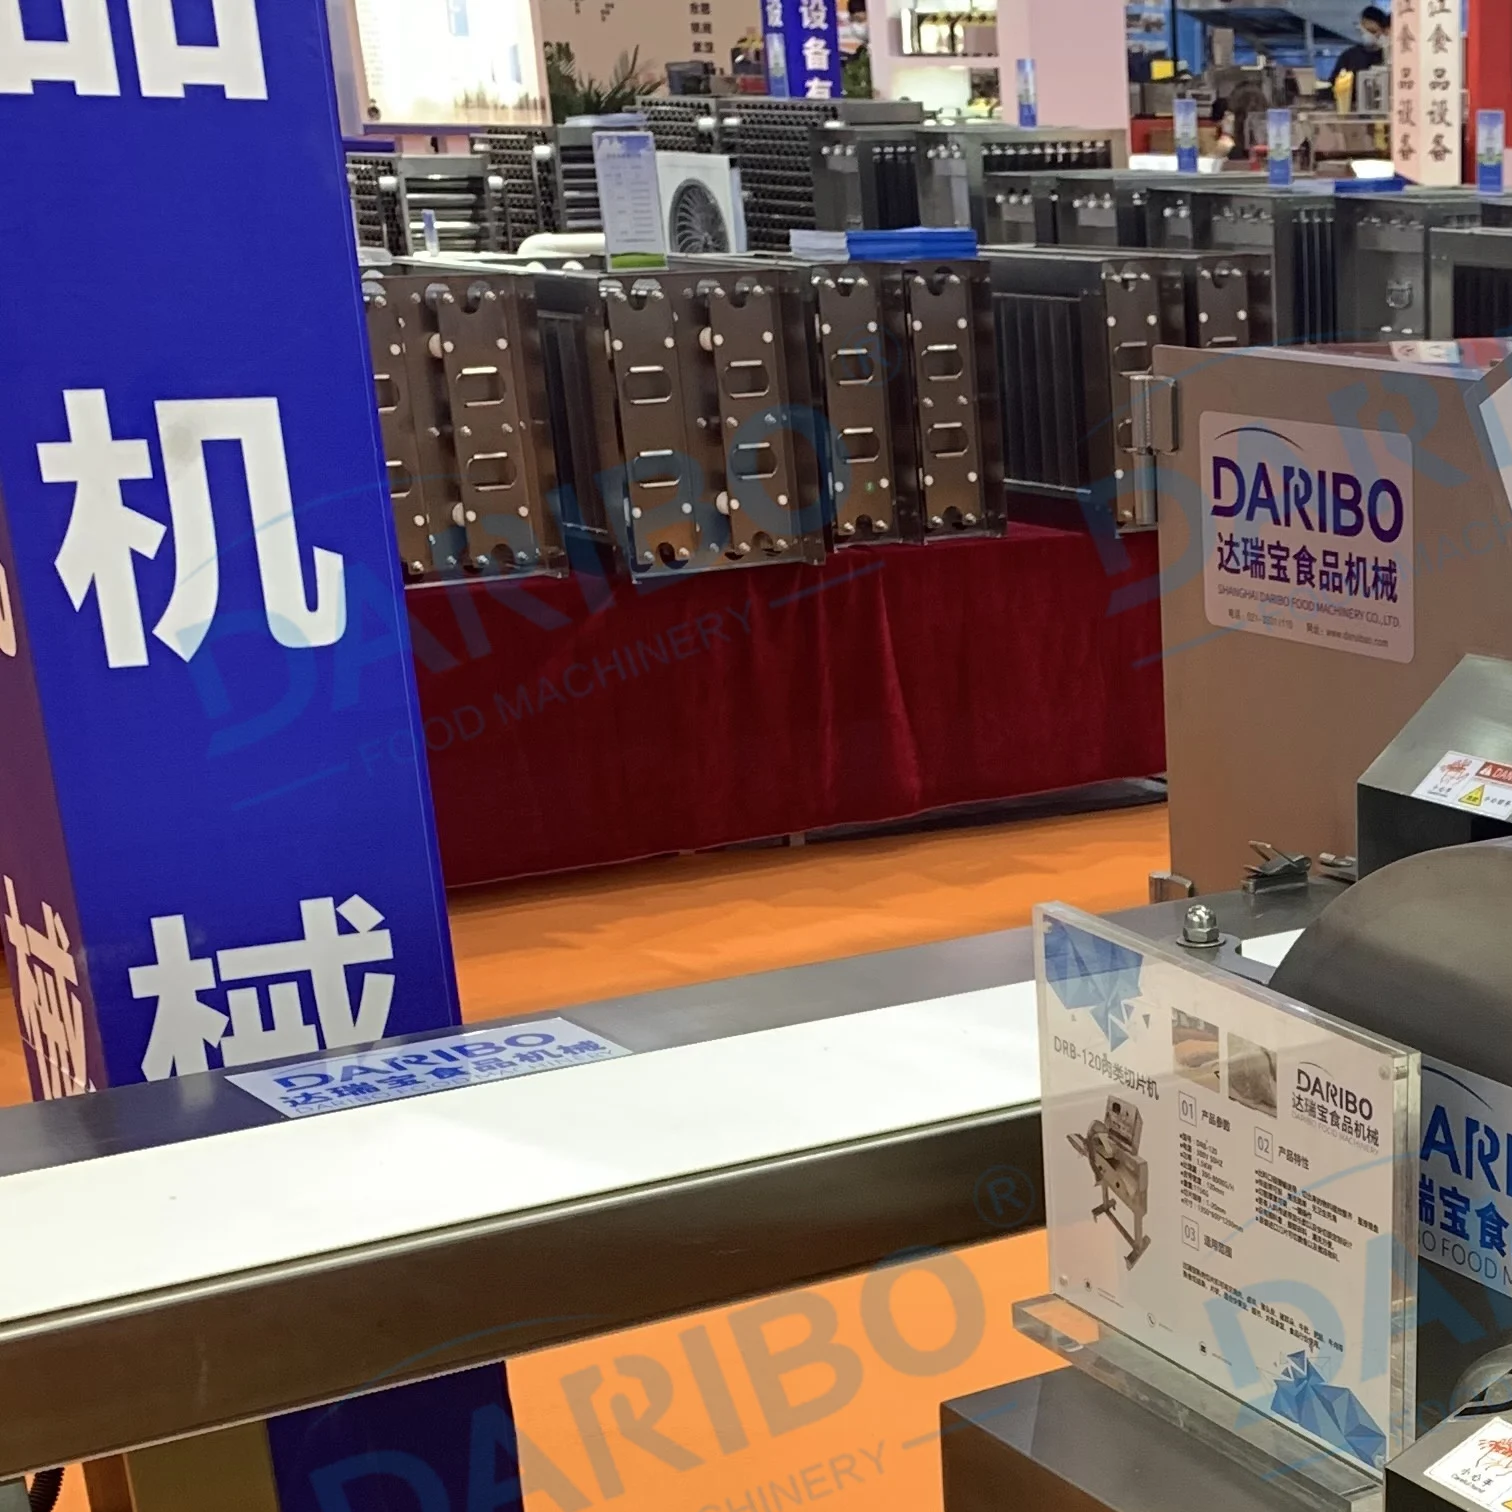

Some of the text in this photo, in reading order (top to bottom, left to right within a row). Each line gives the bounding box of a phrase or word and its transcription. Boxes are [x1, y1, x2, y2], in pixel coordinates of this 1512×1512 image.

[1211, 456, 1404, 543] DARIBO
[1217, 532, 1398, 603] 达瑞宝食品机械
[273, 1032, 556, 1093] DARIBO
[281, 1039, 606, 1108] 达瑞宝食品机械
[1181, 1099, 1194, 1120] 01
[1292, 1091, 1380, 1147] 达瑞宝食品机械
[1296, 1068, 1373, 1121] DARIBO
[1257, 1135, 1270, 1154] 02
[1184, 1224, 1196, 1242] 03
[1441, 1236, 1498, 1280] FOOD
[1461, 1467, 1493, 1487] 小心手
